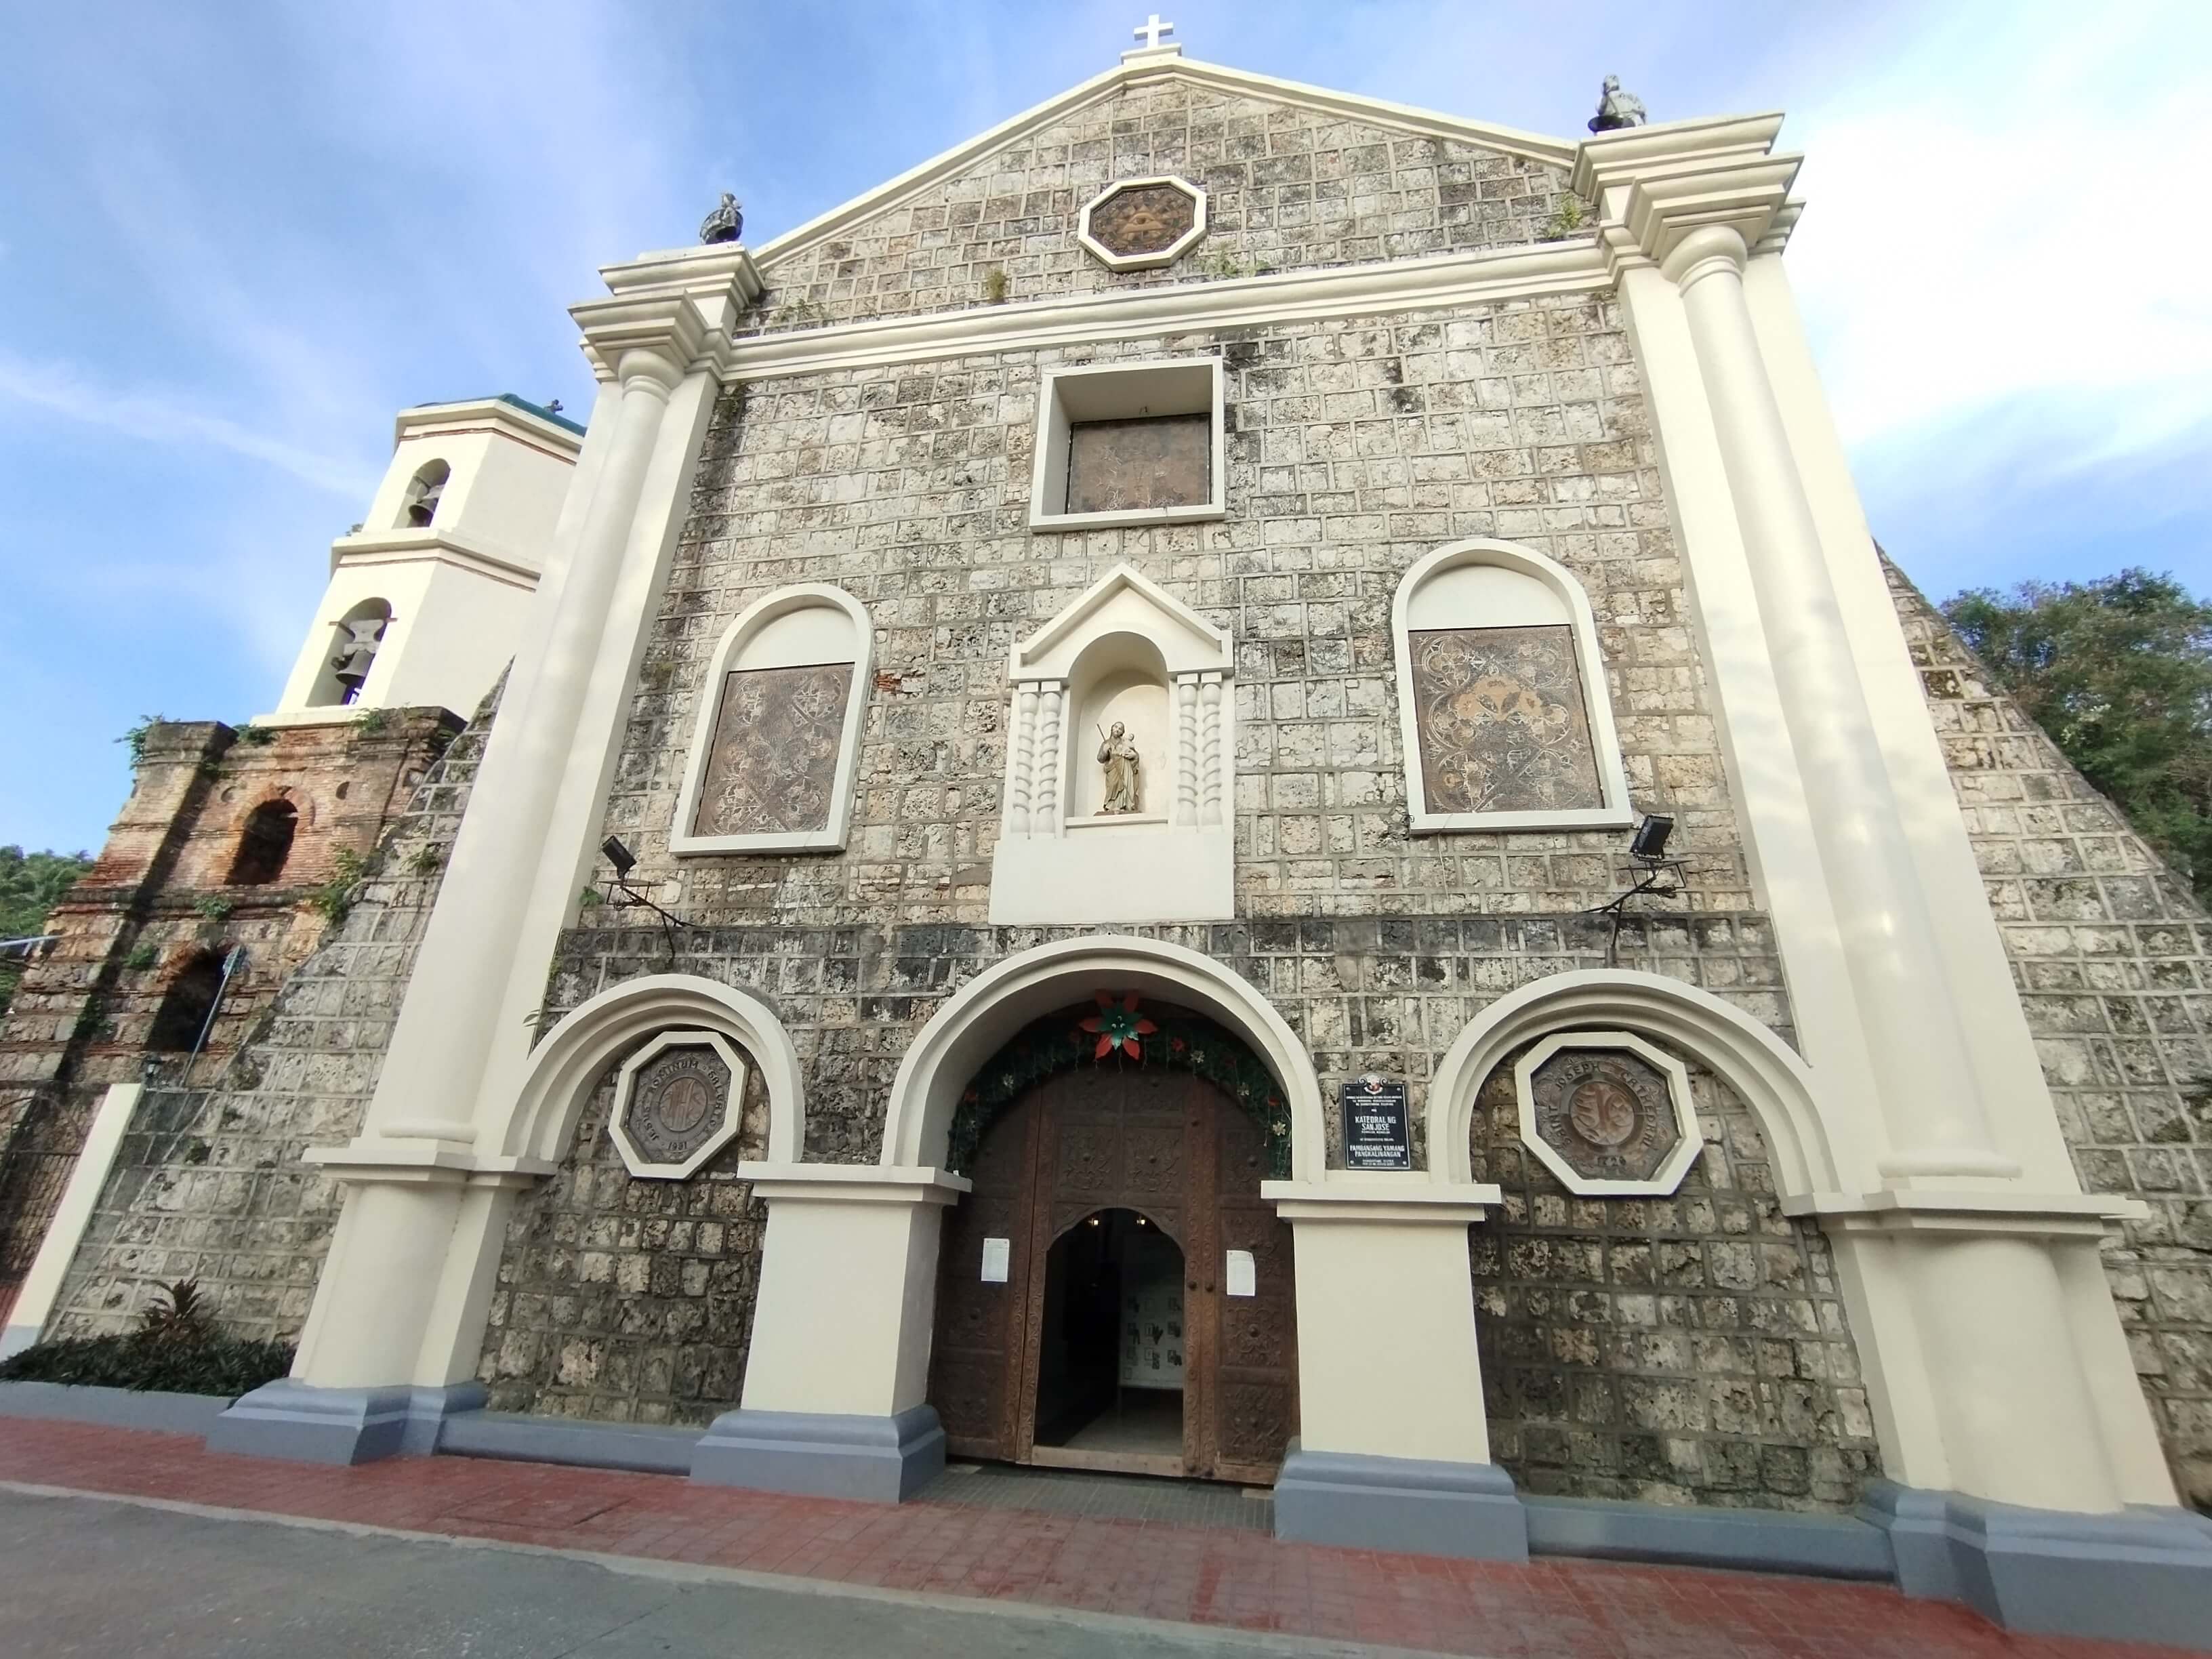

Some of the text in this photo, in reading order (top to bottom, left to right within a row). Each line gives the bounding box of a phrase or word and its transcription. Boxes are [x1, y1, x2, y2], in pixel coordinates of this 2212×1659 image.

[1355, 1115, 1397, 1124] KATEDRAL NG
[1548, 1062, 1656, 1147] SAINT JOSEPH CATHEDRAL
